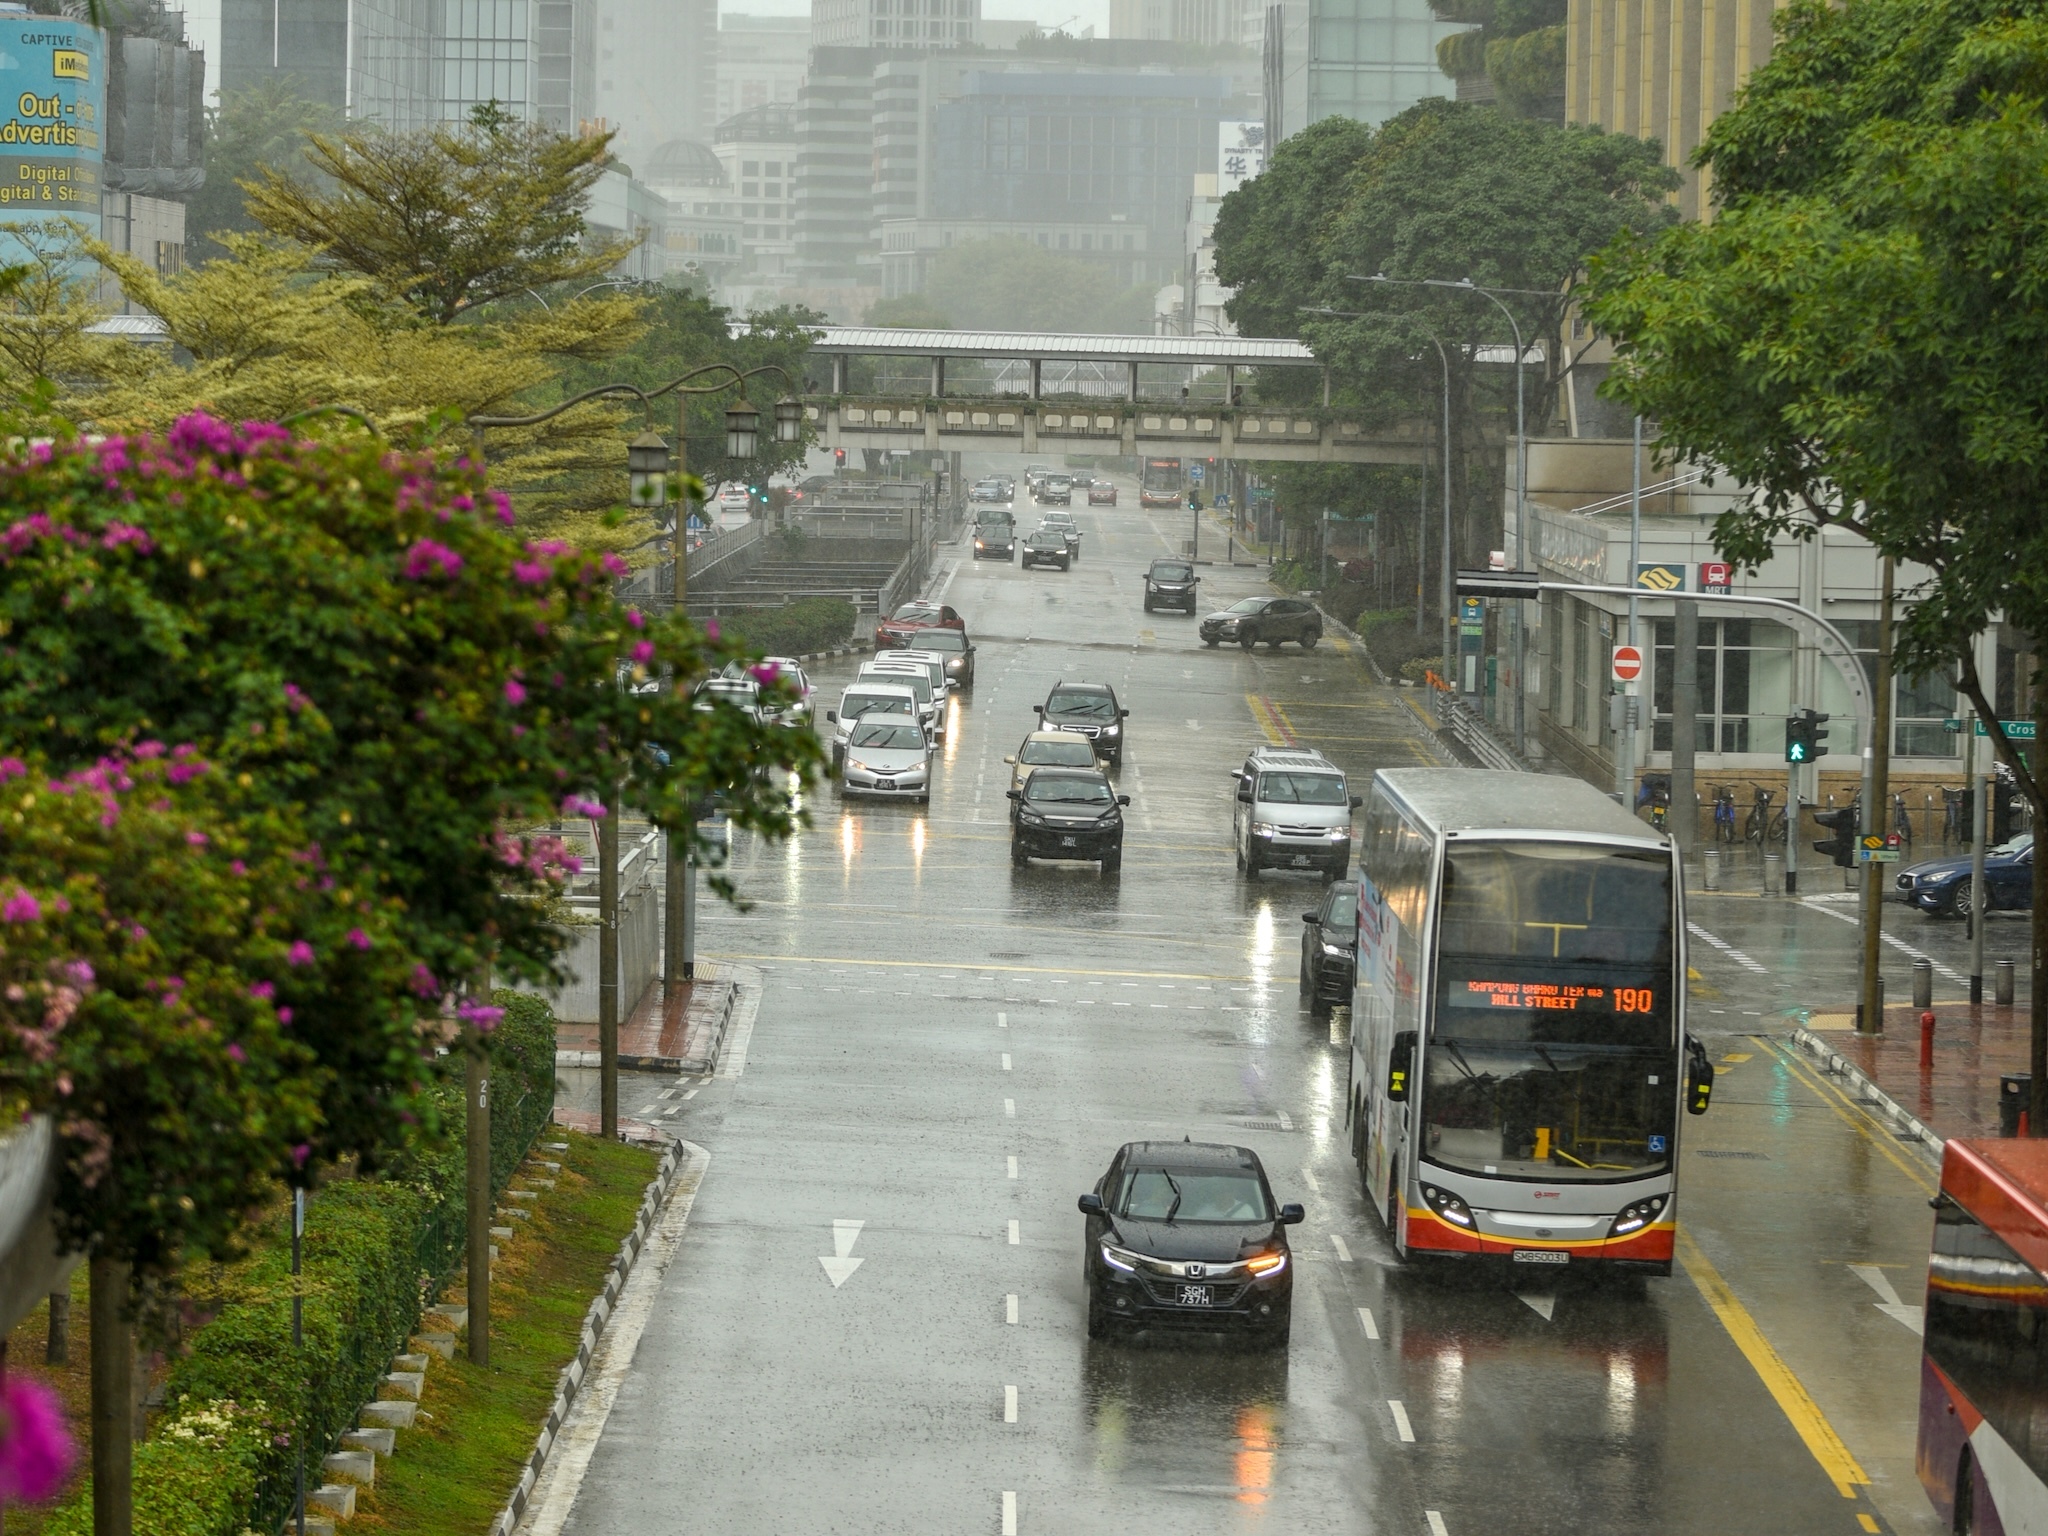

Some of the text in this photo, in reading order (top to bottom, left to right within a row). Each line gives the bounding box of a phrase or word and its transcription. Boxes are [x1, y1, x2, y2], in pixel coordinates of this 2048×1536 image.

[21, 33, 73, 46] CAPTIVE
[19, 91, 61, 118] Out
[0, 118, 92, 147] dvertis
[20, 164, 70, 184] Digital
[0, 184, 36, 203] gital
[42, 185, 53, 200] &
[1705, 585, 1727, 595] MRT
[2008, 723, 2036, 735] Cros
[610, 910, 616, 930] 18
[2035, 948, 2042, 970] 19
[1491, 993, 1577, 1009] HILL STREET
[1613, 988, 1652, 1013] 190
[480, 1079, 488, 1109] 20
[1514, 1251, 1568, 1262] SMB5003U
[1180, 1293, 1209, 1305] 737H
[1184, 1285, 1206, 1296] SGH
